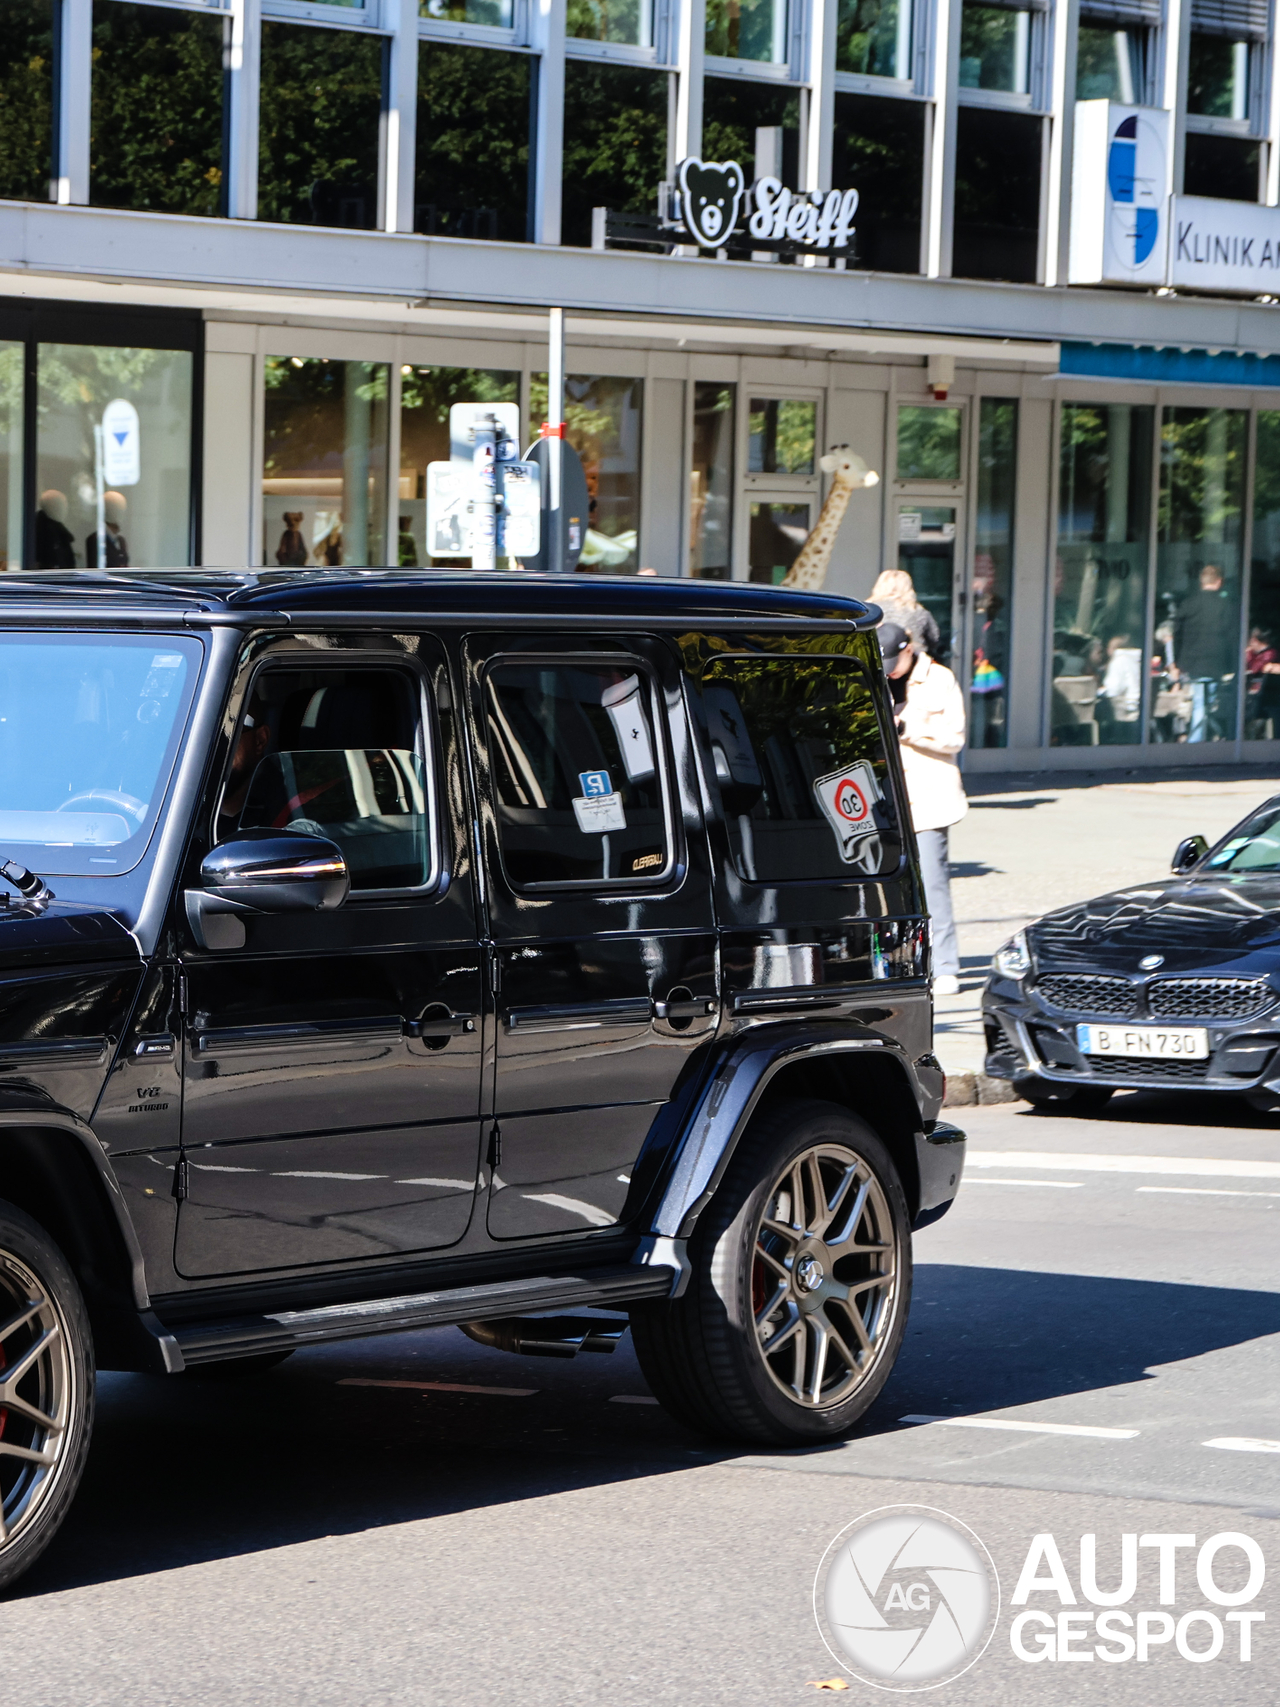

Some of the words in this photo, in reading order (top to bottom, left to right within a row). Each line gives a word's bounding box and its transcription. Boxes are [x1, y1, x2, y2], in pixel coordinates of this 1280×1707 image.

[749, 175, 859, 248] Steiff
[1177, 220, 1255, 267] KLINIK
[1098, 1031, 1111, 1050] B
